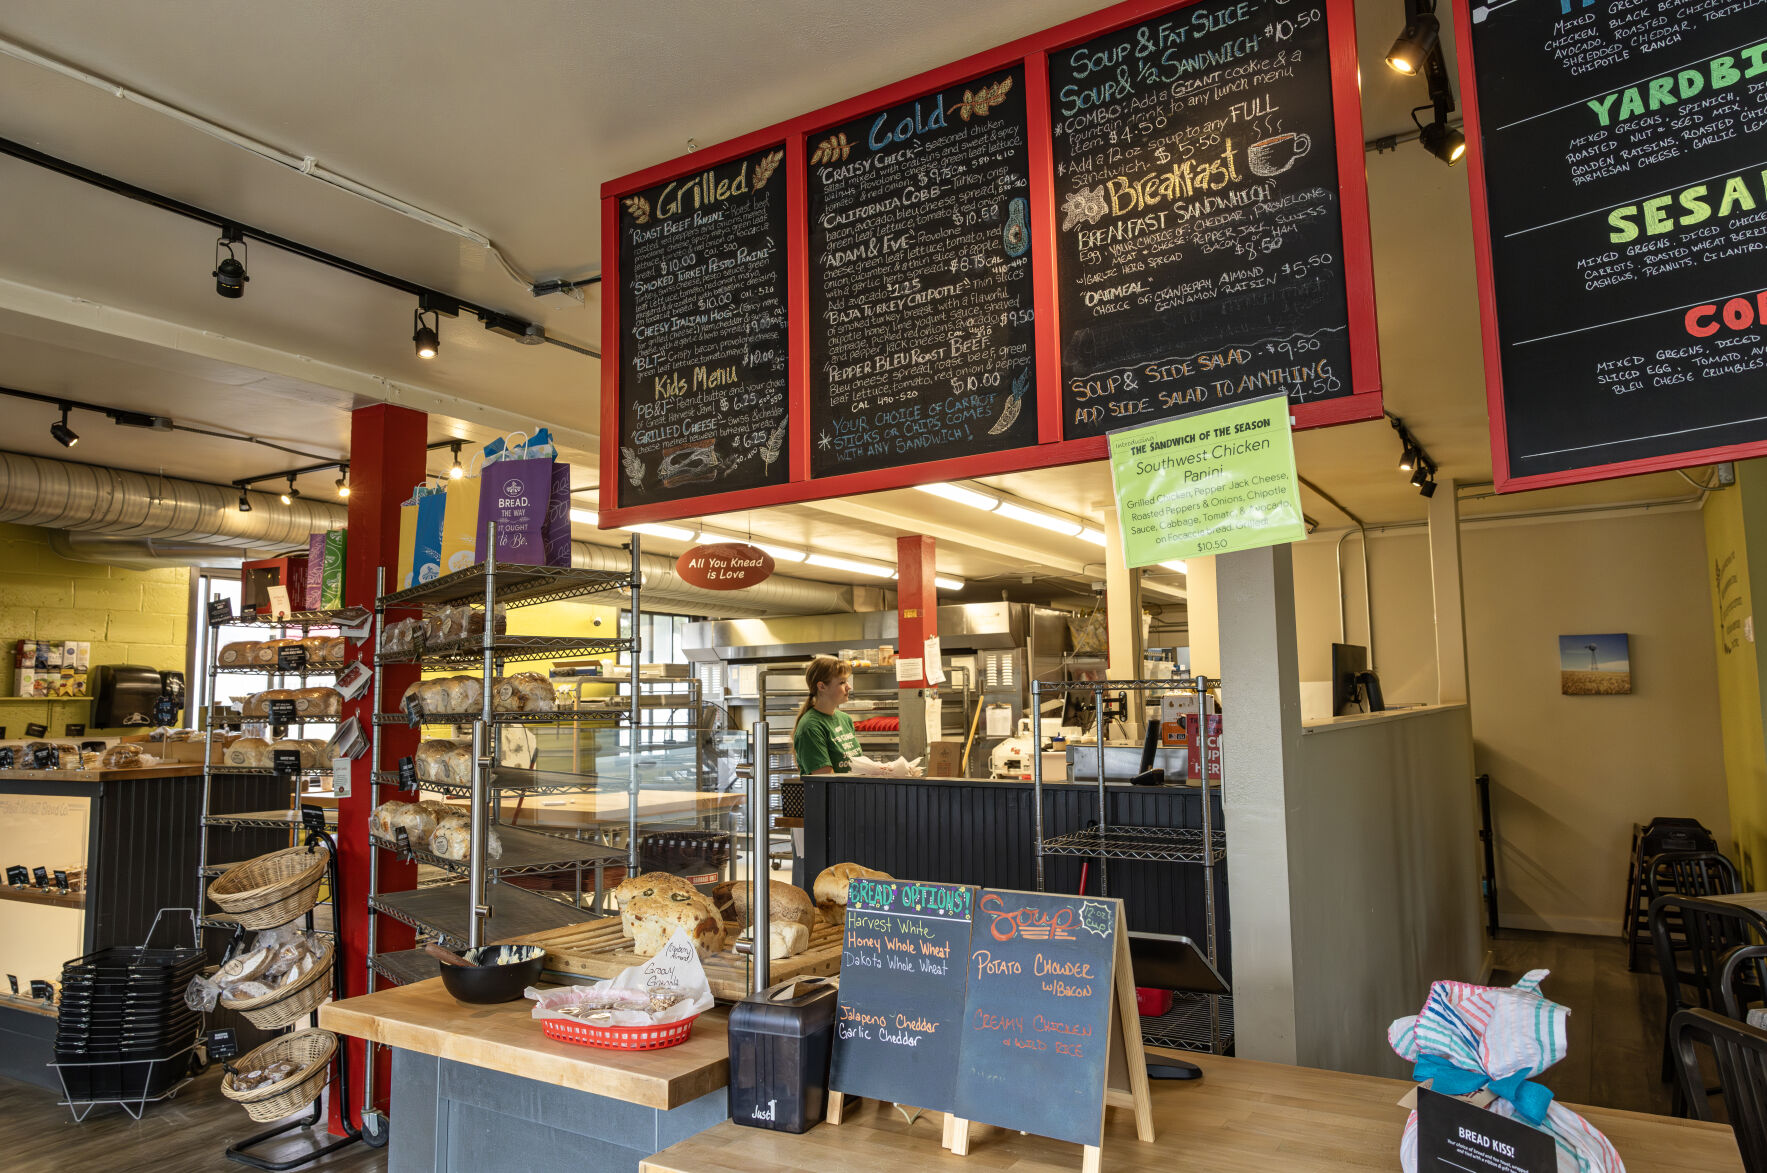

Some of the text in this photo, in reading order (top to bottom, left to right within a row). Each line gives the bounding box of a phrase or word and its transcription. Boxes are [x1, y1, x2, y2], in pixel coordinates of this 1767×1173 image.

[1554, 14, 1596, 35] MIXED
[1608, 9, 1651, 29] BLACK
[1615, 16, 1667, 40] ROASTED
[1070, 43, 1131, 79] SOUP
[1135, 27, 1158, 57] &
[1159, 22, 1190, 50] FAT
[1563, 43, 1622, 67] SHREDDED
[1571, 34, 1681, 76] CHIPOTLE RANCH
[1131, 58, 1270, 109] Add GIANT cookie
[1214, 77, 1248, 100] lunch
[1254, 65, 1294, 85] menu
[868, 94, 948, 151] Cold
[970, 119, 1004, 137] chicken
[1069, 153, 1092, 174] Add
[1149, 135, 1183, 154] soup
[1203, 118, 1228, 138] any
[1229, 93, 1279, 124] FULL
[962, 136, 989, 150] sweet
[1566, 115, 1703, 164] ROASTED NUT SEED
[1570, 130, 1607, 149] MIXED
[1571, 118, 1733, 175] GOLDEN ROASTED
[1573, 129, 1736, 186] PARMESAN GARLIC
[657, 161, 748, 219] Grilled
[1107, 138, 1242, 217] Breakfast
[1607, 170, 1767, 243] SESA
[664, 218, 691, 235] BEEF
[1577, 226, 1720, 269] MIXED DICED
[1644, 236, 1725, 265] ROASTED WHEAT
[875, 351, 909, 372] BLEU
[1144, 361, 1195, 383] SIDE
[1198, 349, 1251, 370] SALAD
[1596, 335, 1760, 373] MIXED DICED
[655, 366, 738, 400] Kids Menu
[1074, 359, 1332, 424] ADD SIDE SALAD TO ANYTHING
[1598, 370, 1639, 384] SLICED
[1612, 372, 1694, 395] BLEU CHEESE
[833, 405, 921, 435] YOUR CHOICE
[834, 407, 991, 449] STICKS CHIPS COMES
[837, 442, 889, 461] WITH ANY
[1131, 418, 1271, 456] THE SANDWICH OF THE SEASON
[1136, 438, 1270, 475] Southwest Chicken
[1184, 465, 1223, 484] Panini
[499, 497, 530, 508] BREAD.
[1127, 496, 1155, 509] Grilled
[1194, 485, 1225, 499] Pepper
[1229, 480, 1249, 490] Jack
[1252, 473, 1289, 486] Cheese,
[1131, 486, 1286, 521] Roasted Peppers & Onions, Chipotle
[1131, 523, 1158, 535] Sauce,
[1159, 517, 1201, 532] Cabbage,
[1156, 536, 1167, 544] on
[1168, 529, 1205, 542] Focaccia
[1197, 539, 1228, 552] $10.50
[689, 557, 764, 568] All You Knead
[707, 569, 745, 579] is Love
[849, 883, 892, 905] BREAD
[848, 912, 935, 938] Harvest White
[980, 894, 1084, 941] Soup
[848, 931, 950, 958] Honey Whole Wheat
[844, 951, 948, 975] Dakota Whole Wheat
[972, 950, 1094, 980] POTATO CHOWDER
[840, 1005, 939, 1034] Jalapeno Cheddar
[973, 1008, 1023, 1032] CREAMY
[838, 1022, 922, 1047] Garlic Cheddar
[1459, 1127, 1515, 1158] BREAD KISS!
